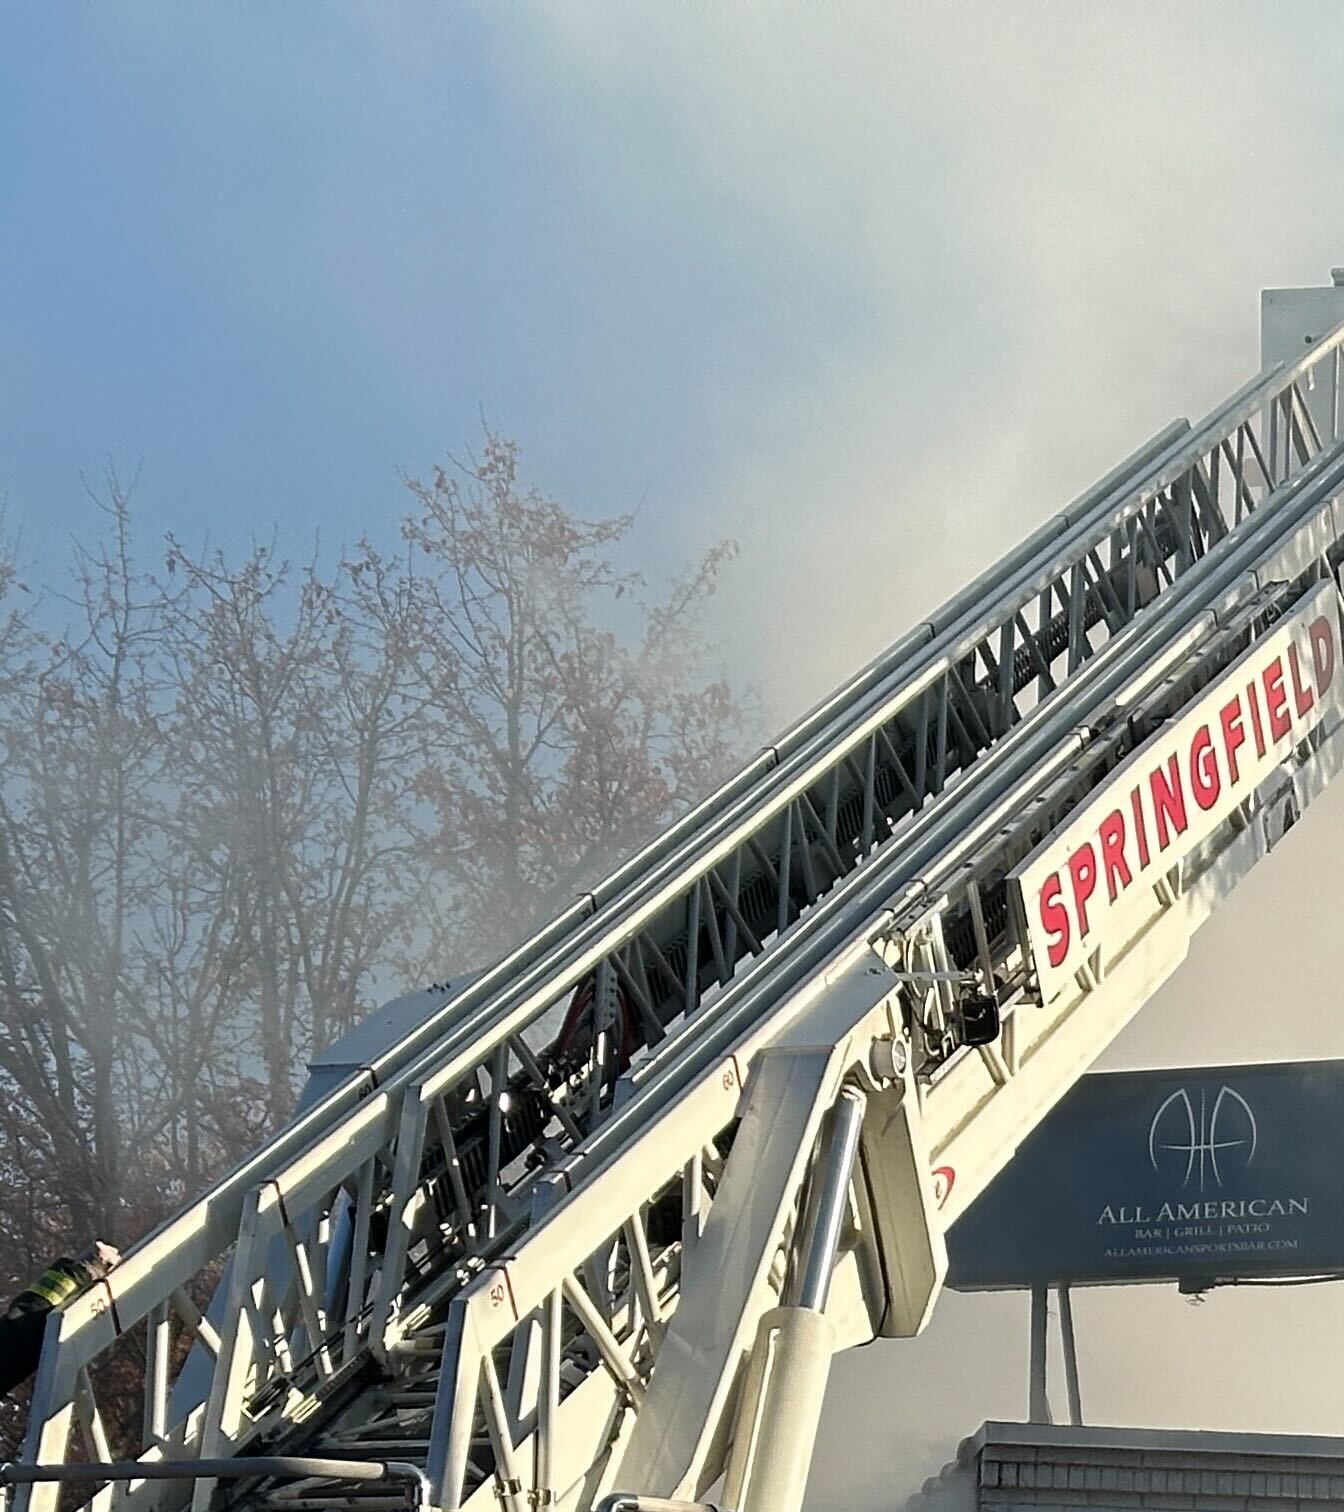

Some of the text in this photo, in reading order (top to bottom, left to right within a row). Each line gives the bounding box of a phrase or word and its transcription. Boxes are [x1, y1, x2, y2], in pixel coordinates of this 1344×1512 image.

[1038, 615, 1335, 968] SPRINGFIELD
[1096, 1197, 1310, 1225] ALL AMERICAN
[1135, 1228, 1163, 1240] BAR
[1174, 1226, 1216, 1238] GRILL
[1227, 1223, 1271, 1235] PATIO
